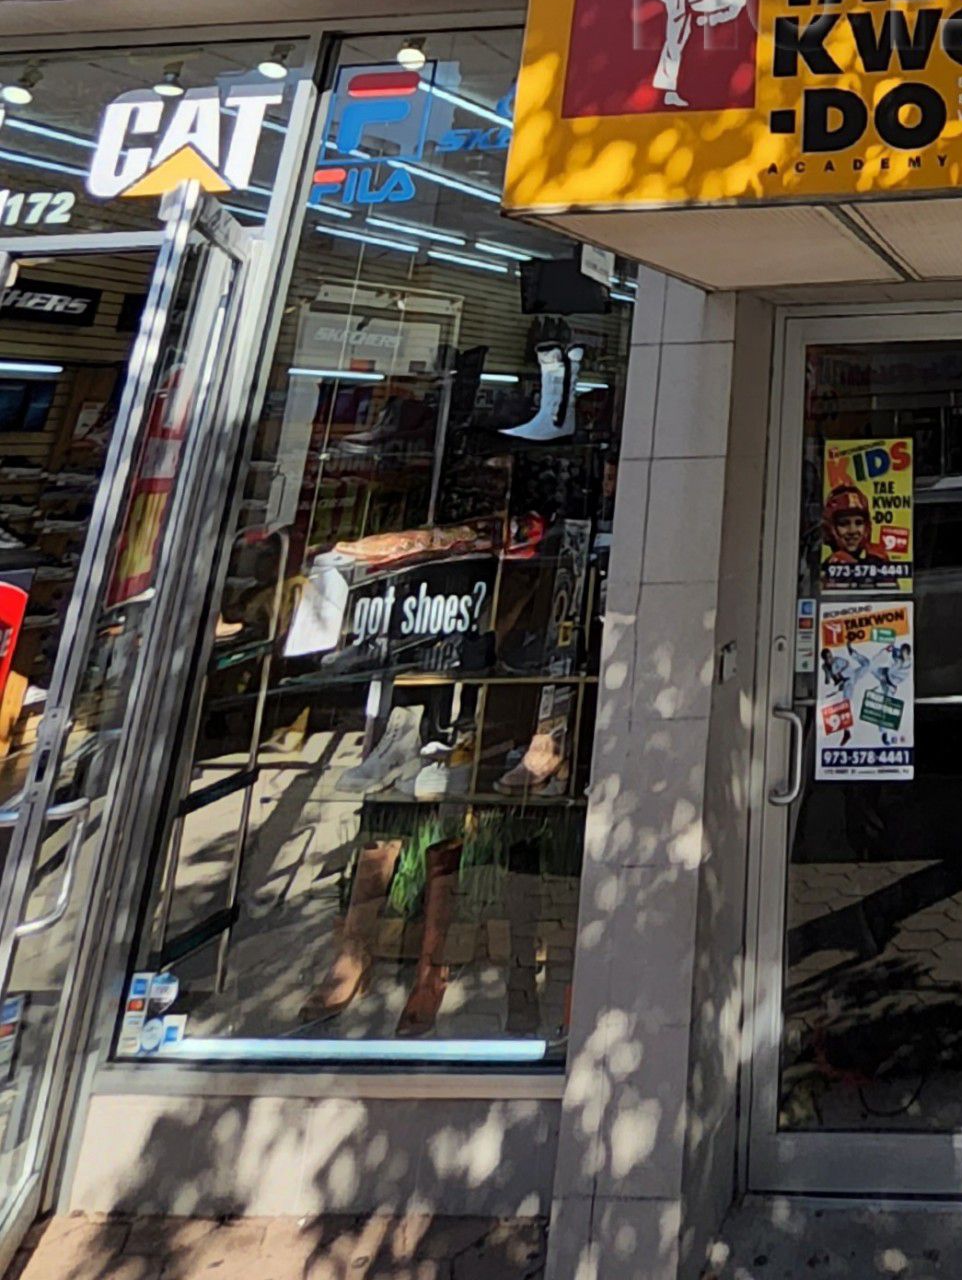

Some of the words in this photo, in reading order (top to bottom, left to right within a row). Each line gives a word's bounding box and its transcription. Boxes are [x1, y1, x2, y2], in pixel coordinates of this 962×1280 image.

[87, 82, 285, 198] CAT
[767, 155, 947, 174] ACADEMY
[308, 168, 416, 204] FILA
[826, 441, 911, 488] KIDS
[872, 495, 911, 509] KWON
[873, 481, 895, 495] TAE
[353, 586, 395, 645] got
[401, 581, 487, 635] shoes?
